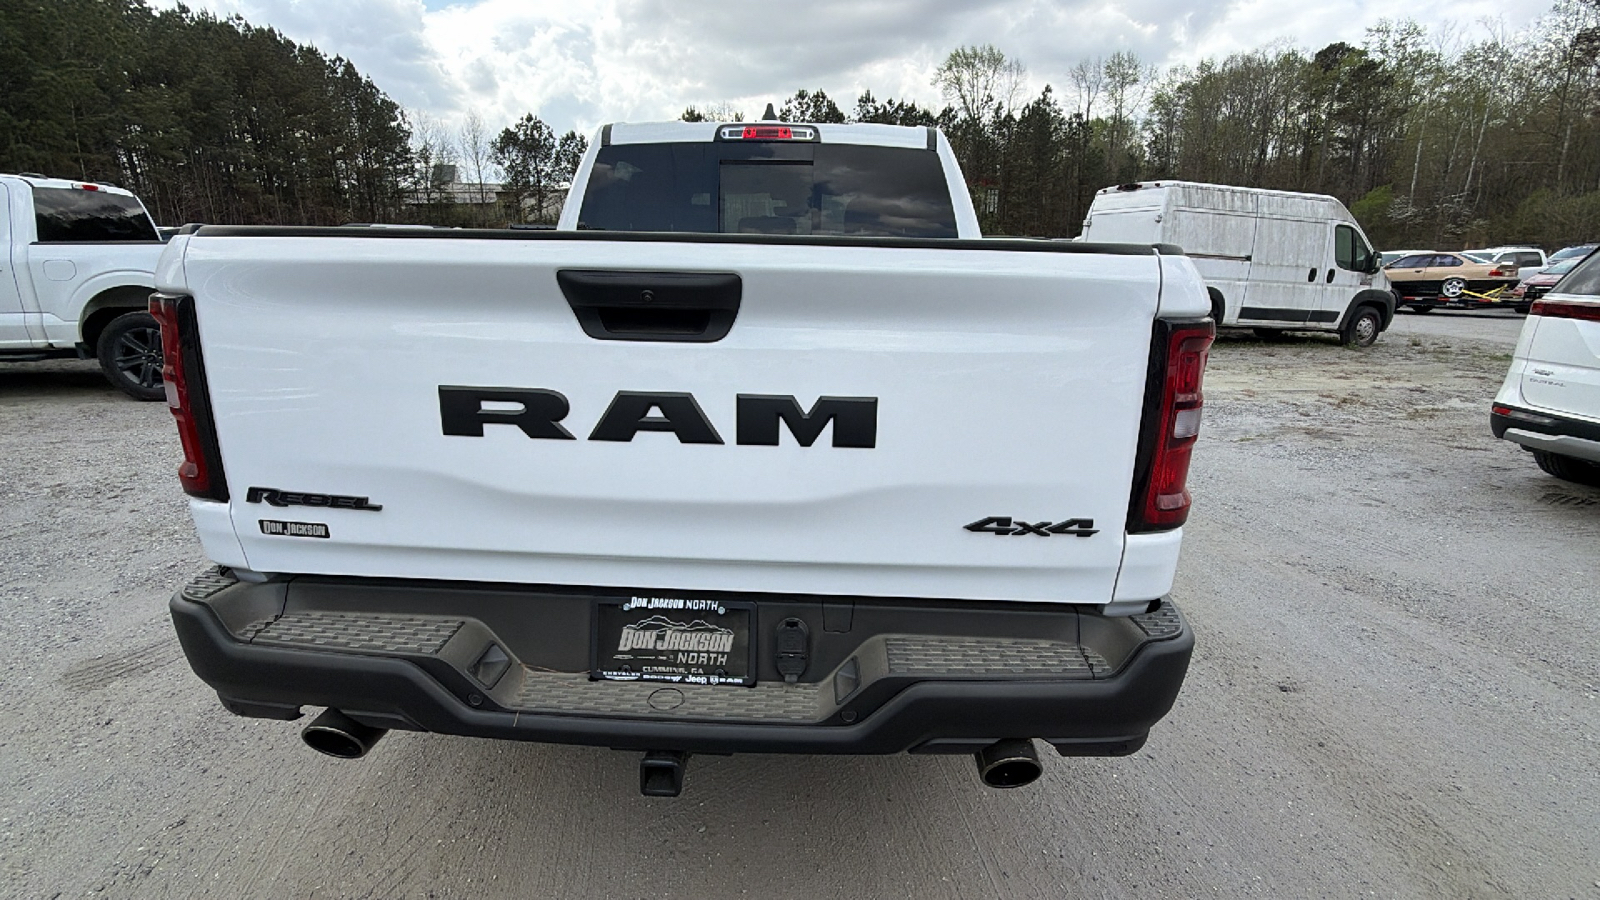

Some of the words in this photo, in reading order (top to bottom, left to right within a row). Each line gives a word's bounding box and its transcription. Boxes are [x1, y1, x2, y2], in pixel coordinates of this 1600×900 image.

[438, 385, 878, 449] RAM
[246, 486, 383, 512] REBEL
[263, 521, 282, 534] DON
[284, 522, 325, 537] JACKSON
[631, 596, 648, 608] DON
[648, 598, 684, 609] JACKSON
[686, 600, 719, 611] NORTH
[618, 627, 657, 651] DON
[656, 629, 734, 652] JACKSON
[676, 652, 728, 666] NORTH
[685, 674, 707, 685] Jeep
